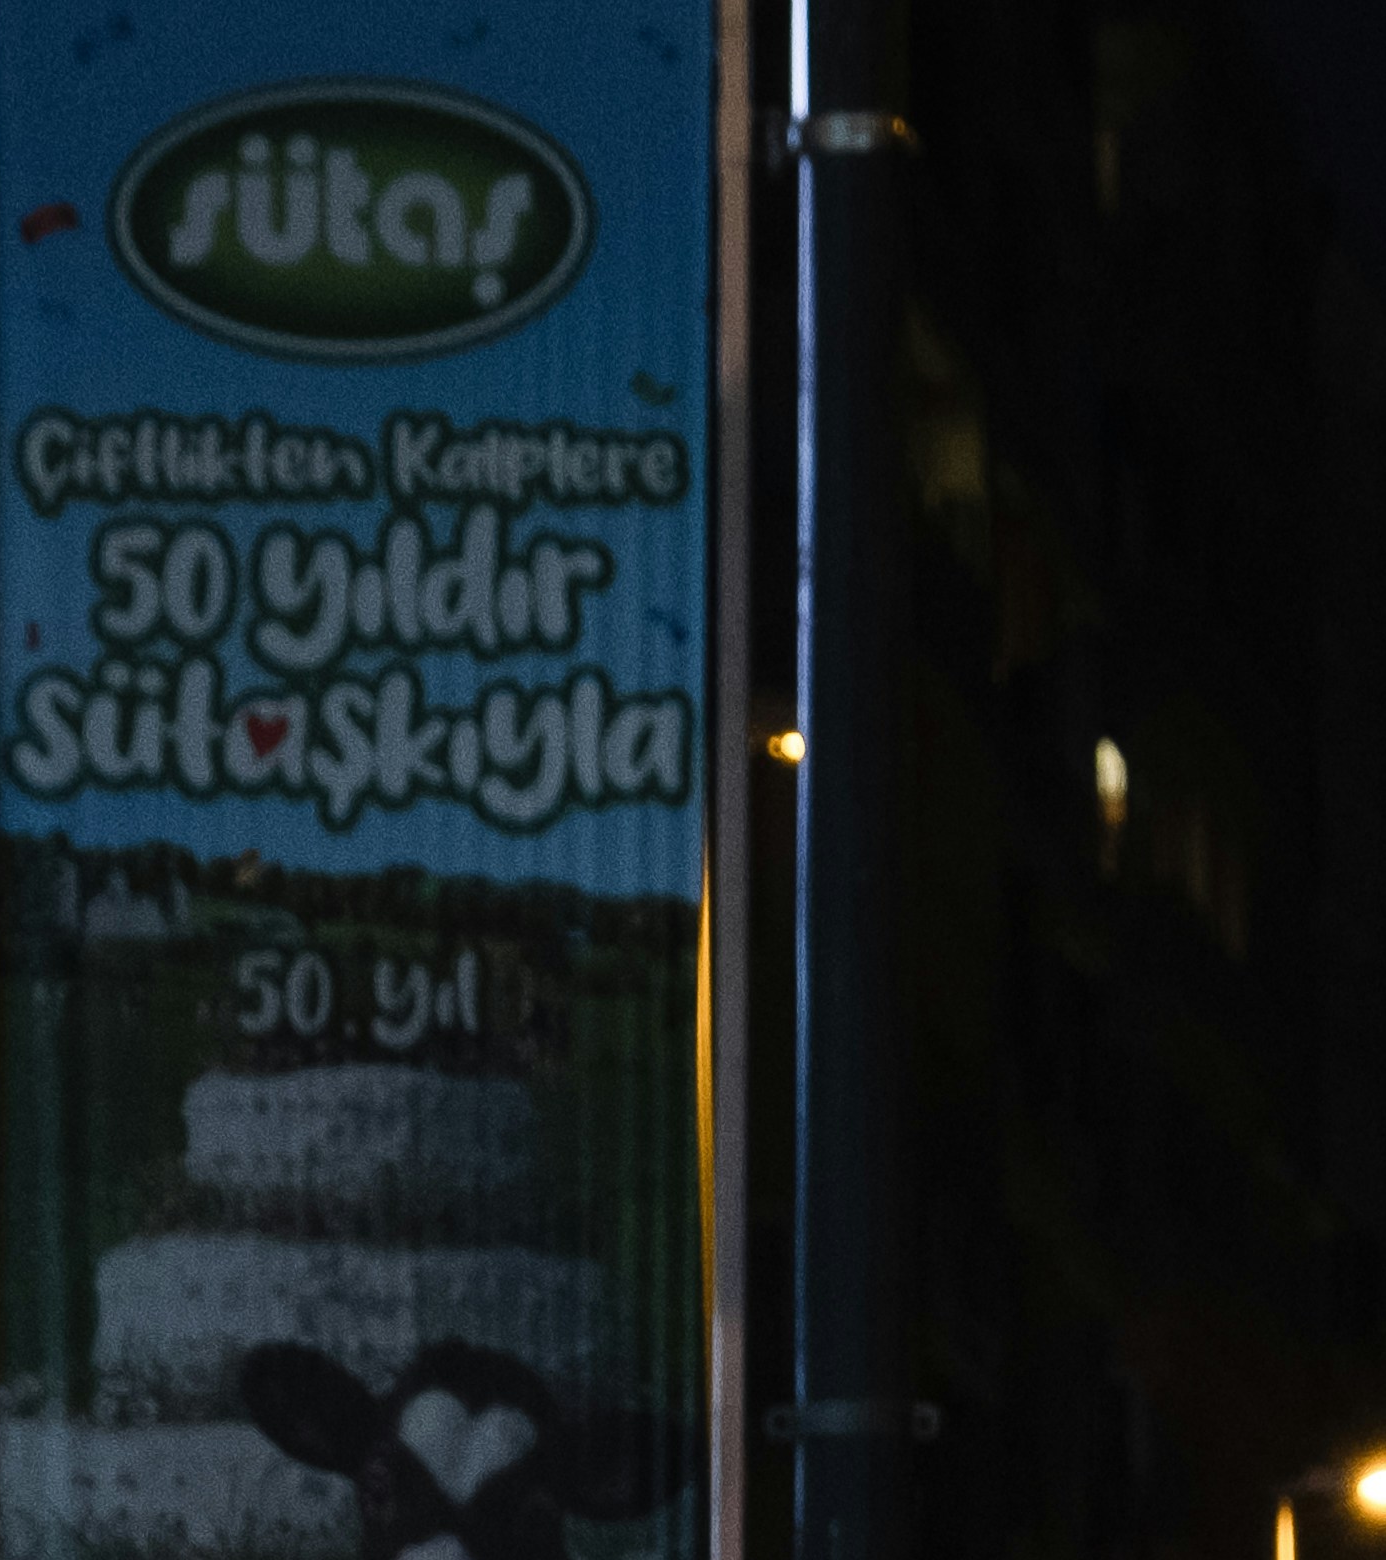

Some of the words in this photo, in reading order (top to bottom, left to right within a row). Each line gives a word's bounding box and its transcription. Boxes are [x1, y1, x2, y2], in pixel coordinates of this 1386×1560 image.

[169, 131, 534, 307] sütaş
[24, 416, 369, 508] Çiftlikten
[389, 420, 681, 498] Kalplere
[101, 524, 227, 640] 50
[255, 506, 605, 668] yıldır
